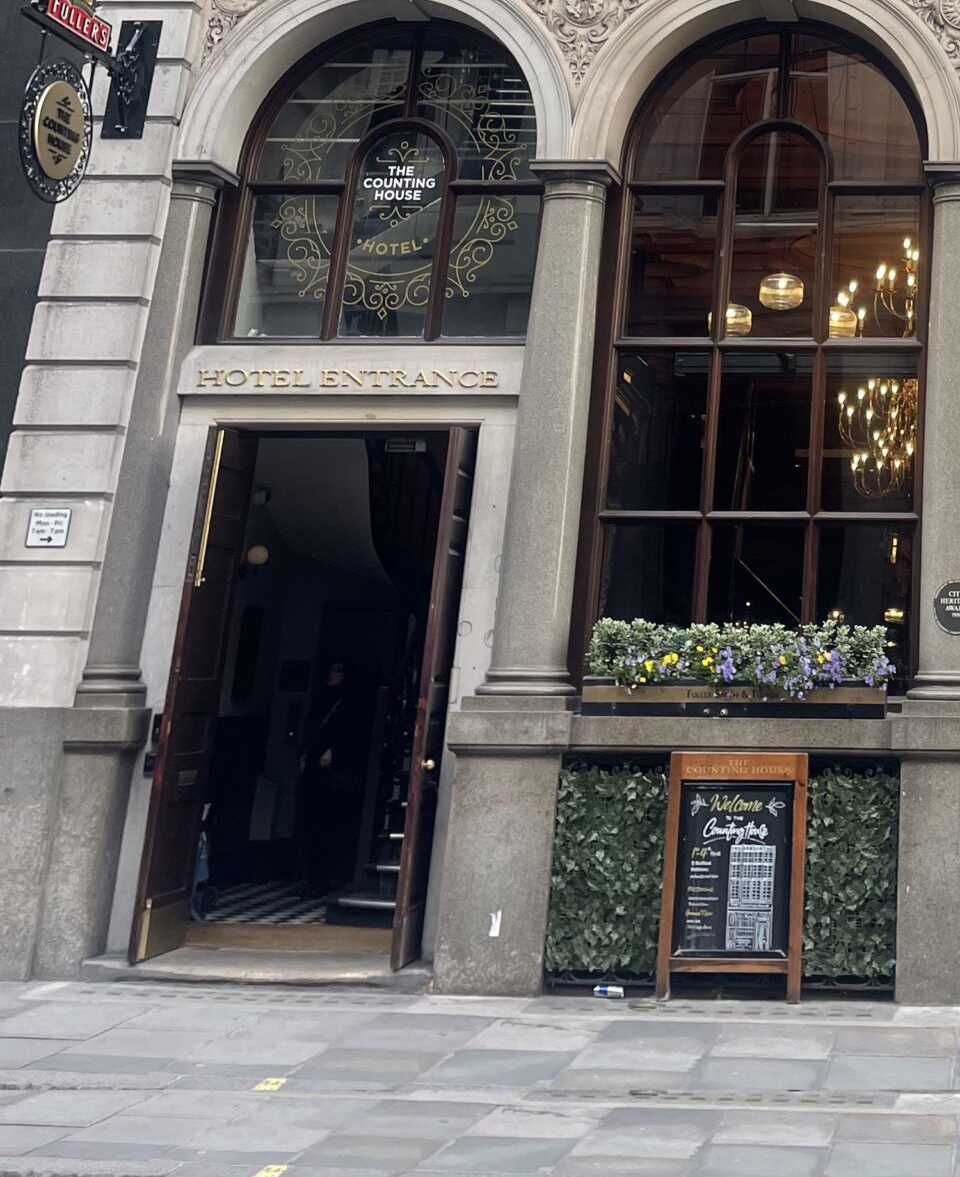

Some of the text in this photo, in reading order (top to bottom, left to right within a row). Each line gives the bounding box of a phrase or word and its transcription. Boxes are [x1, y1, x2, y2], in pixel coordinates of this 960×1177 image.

[57, 108, 72, 124] THE
[43, 116, 80, 143] COUNTING
[48, 133, 72, 155] HOUSE
[388, 166, 415, 176] THE
[363, 178, 436, 189] COUNTING
[374, 190, 422, 201] HOUSE
[362, 239, 422, 255] HOTEL
[196, 369, 499, 389] HOTEL ENTRANCE
[686, 766, 748, 774] COUNTING
[729, 759, 749, 767] THE
[710, 793, 764, 813] Welcome
